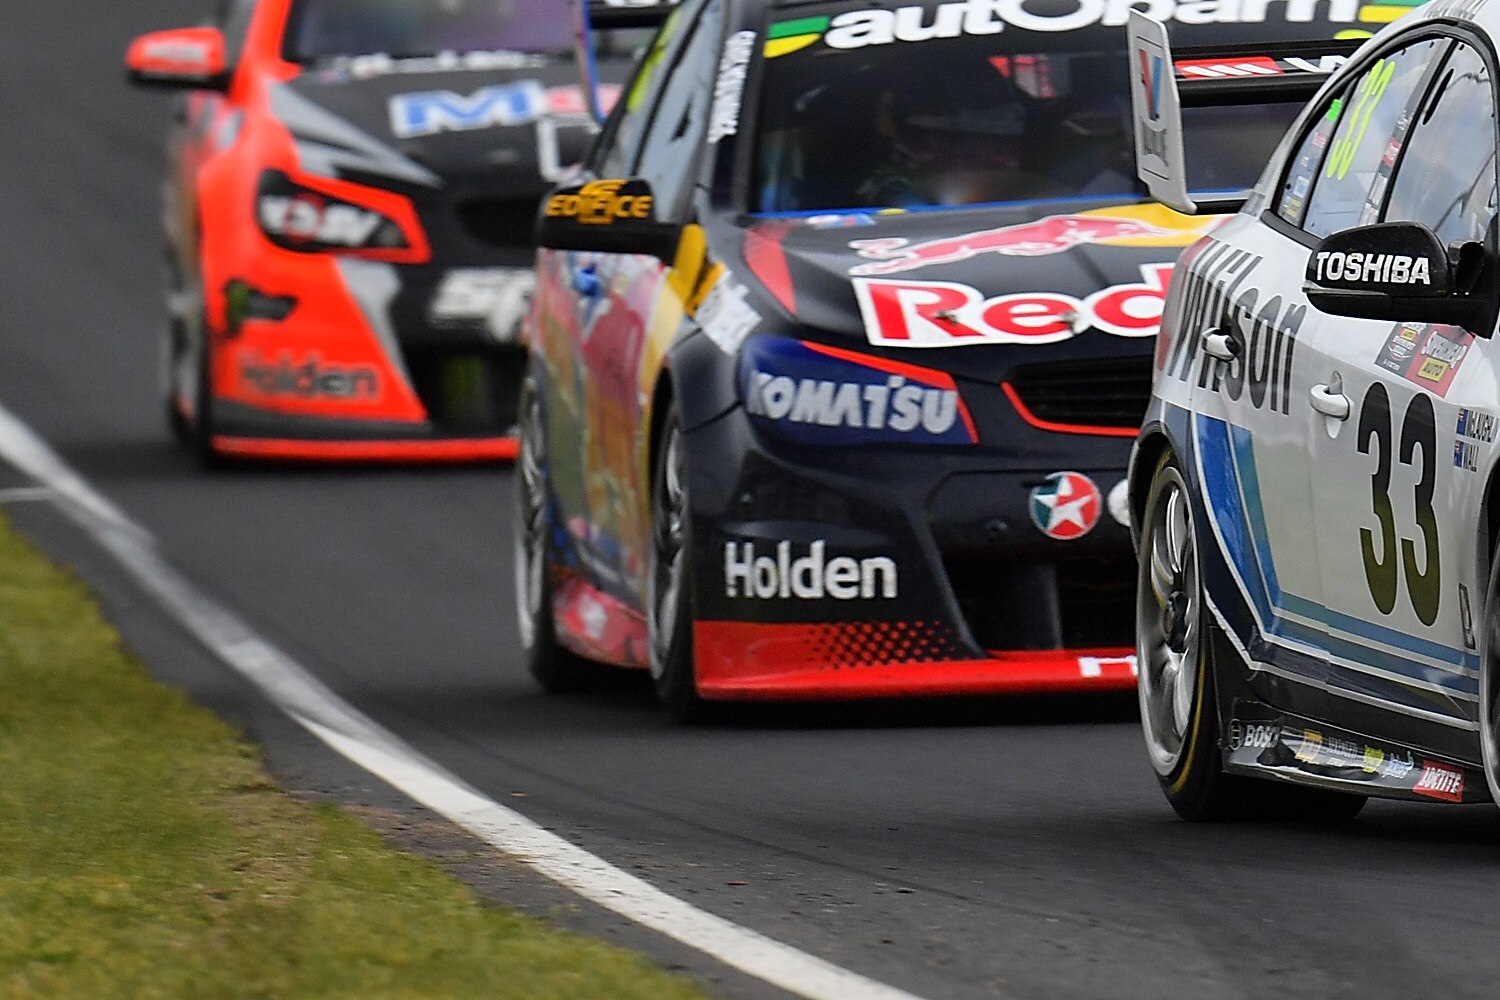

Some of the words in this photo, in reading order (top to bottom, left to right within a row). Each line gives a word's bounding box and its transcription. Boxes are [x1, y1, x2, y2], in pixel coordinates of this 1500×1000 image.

[1316, 250, 1431, 286] TOSHIBA
[864, 264, 1174, 342] Red
[747, 371, 958, 434] KOMATSU
[1357, 381, 1442, 627] 33
[725, 540, 897, 599] Holden
